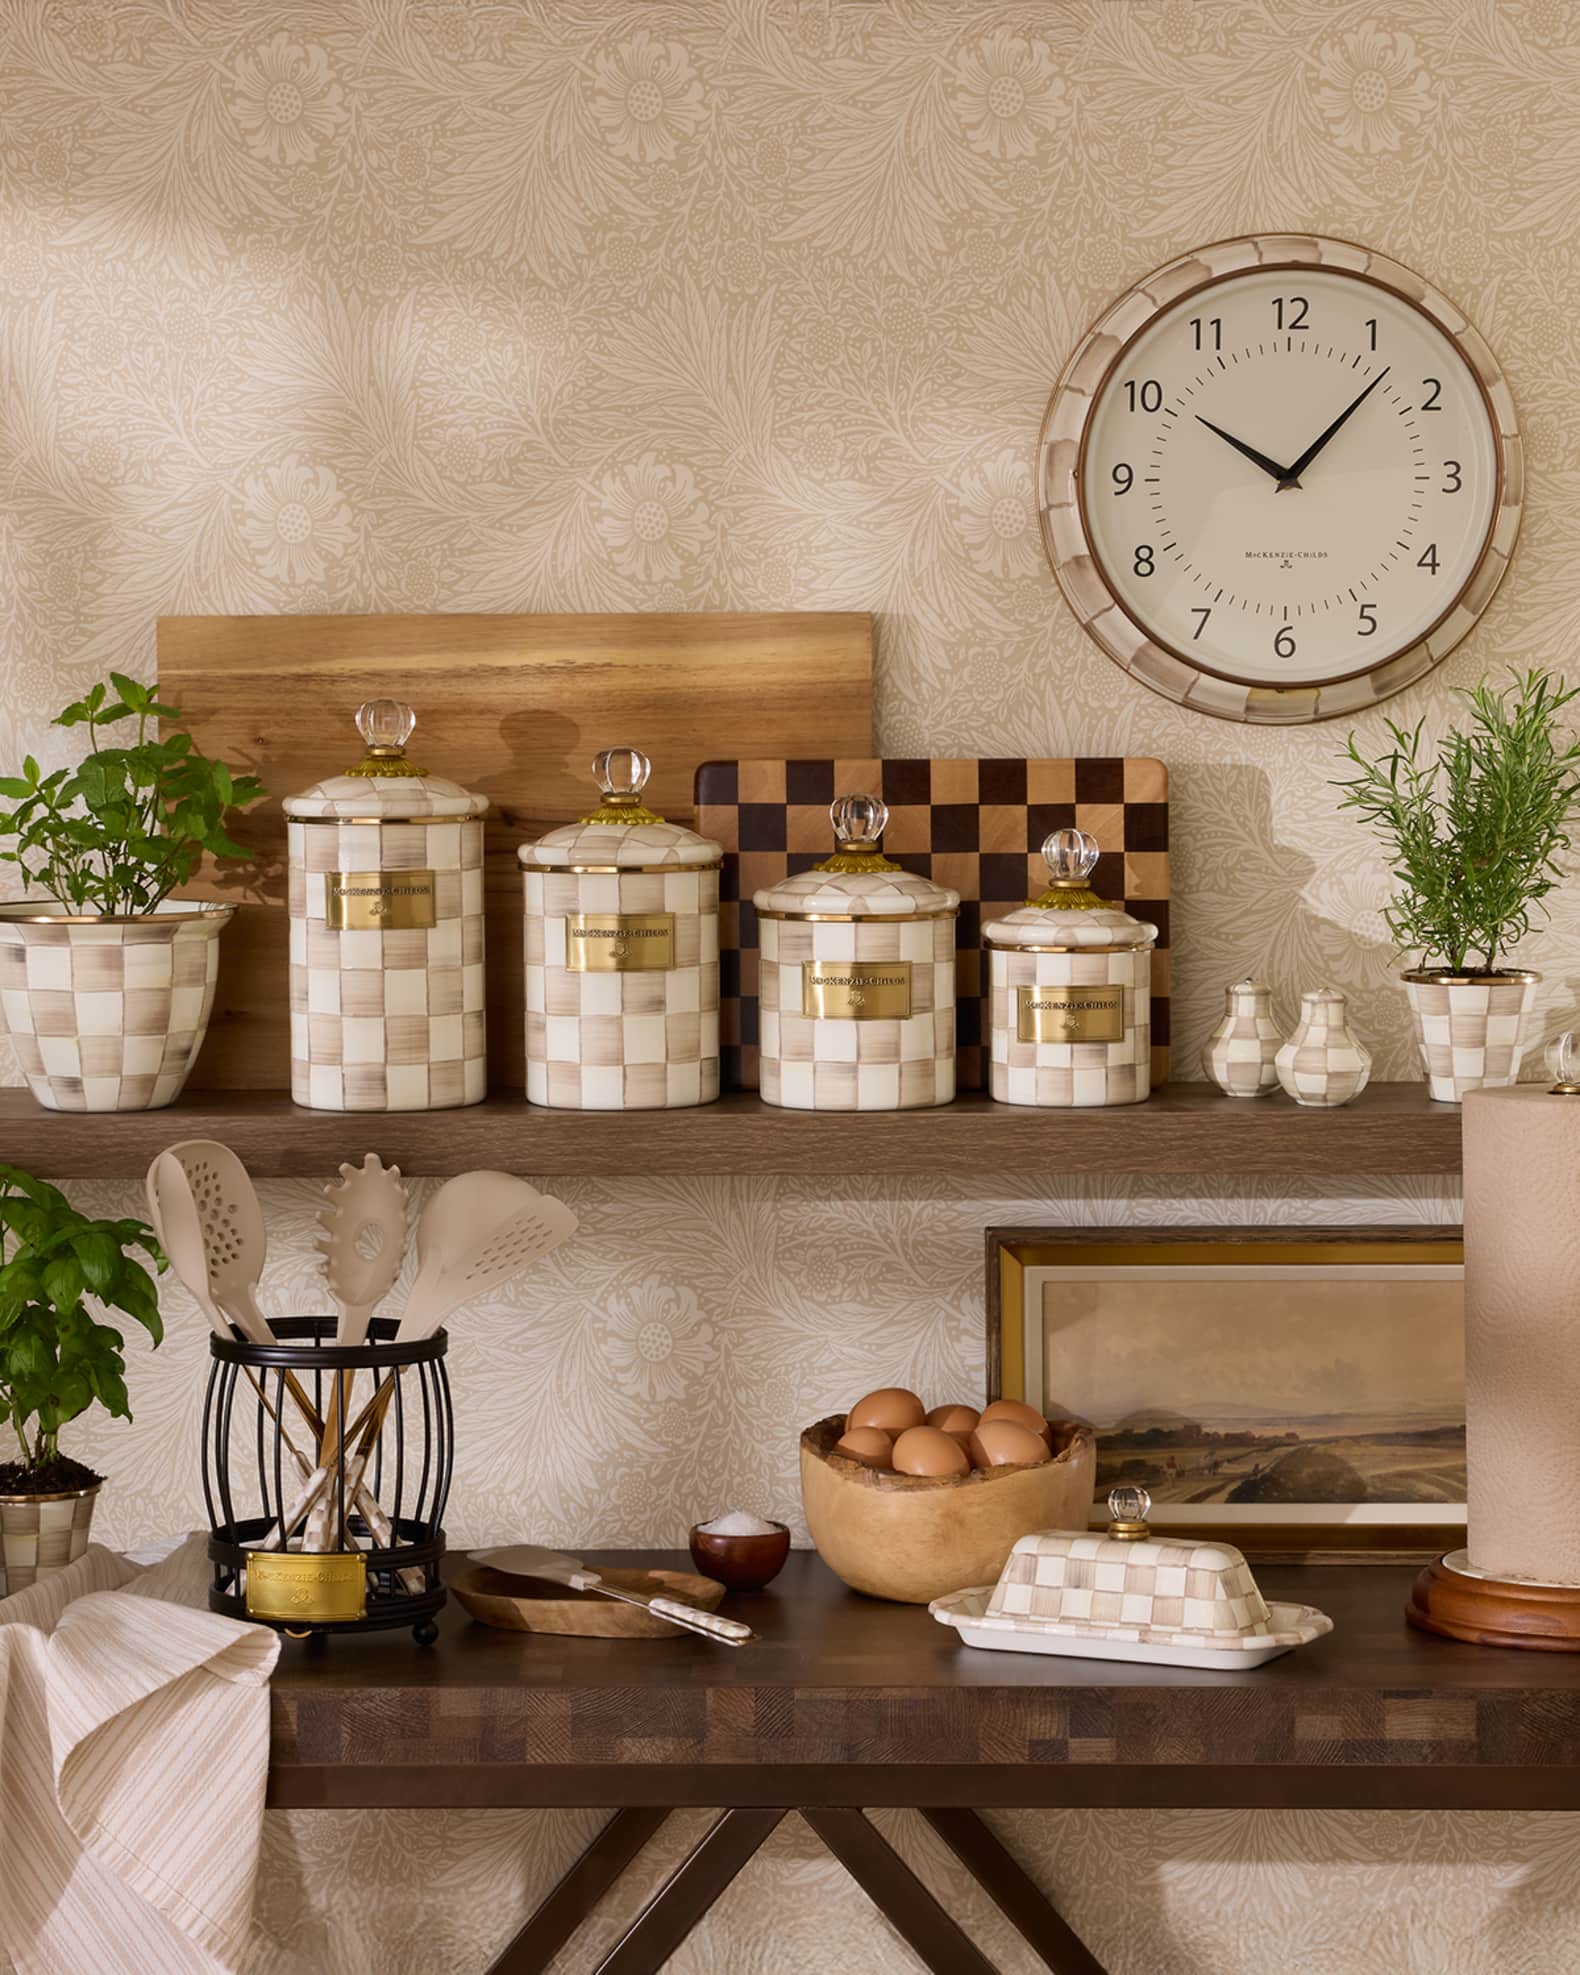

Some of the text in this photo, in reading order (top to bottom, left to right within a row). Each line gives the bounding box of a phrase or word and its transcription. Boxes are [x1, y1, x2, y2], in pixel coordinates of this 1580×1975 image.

[1271, 296, 1310, 331] 12
[1189, 317, 1222, 351] 11
[1365, 318, 1377, 352] 1
[1123, 379, 1163, 413] 10
[1420, 377, 1442, 412] 2
[1111, 462, 1134, 497] 9
[1441, 460, 1462, 494] 3
[1132, 544, 1155, 578] 8
[1416, 543, 1441, 576] 4
[1191, 608, 1212, 640] 7
[1357, 603, 1377, 637] 5
[1274, 625, 1296, 659] 6
